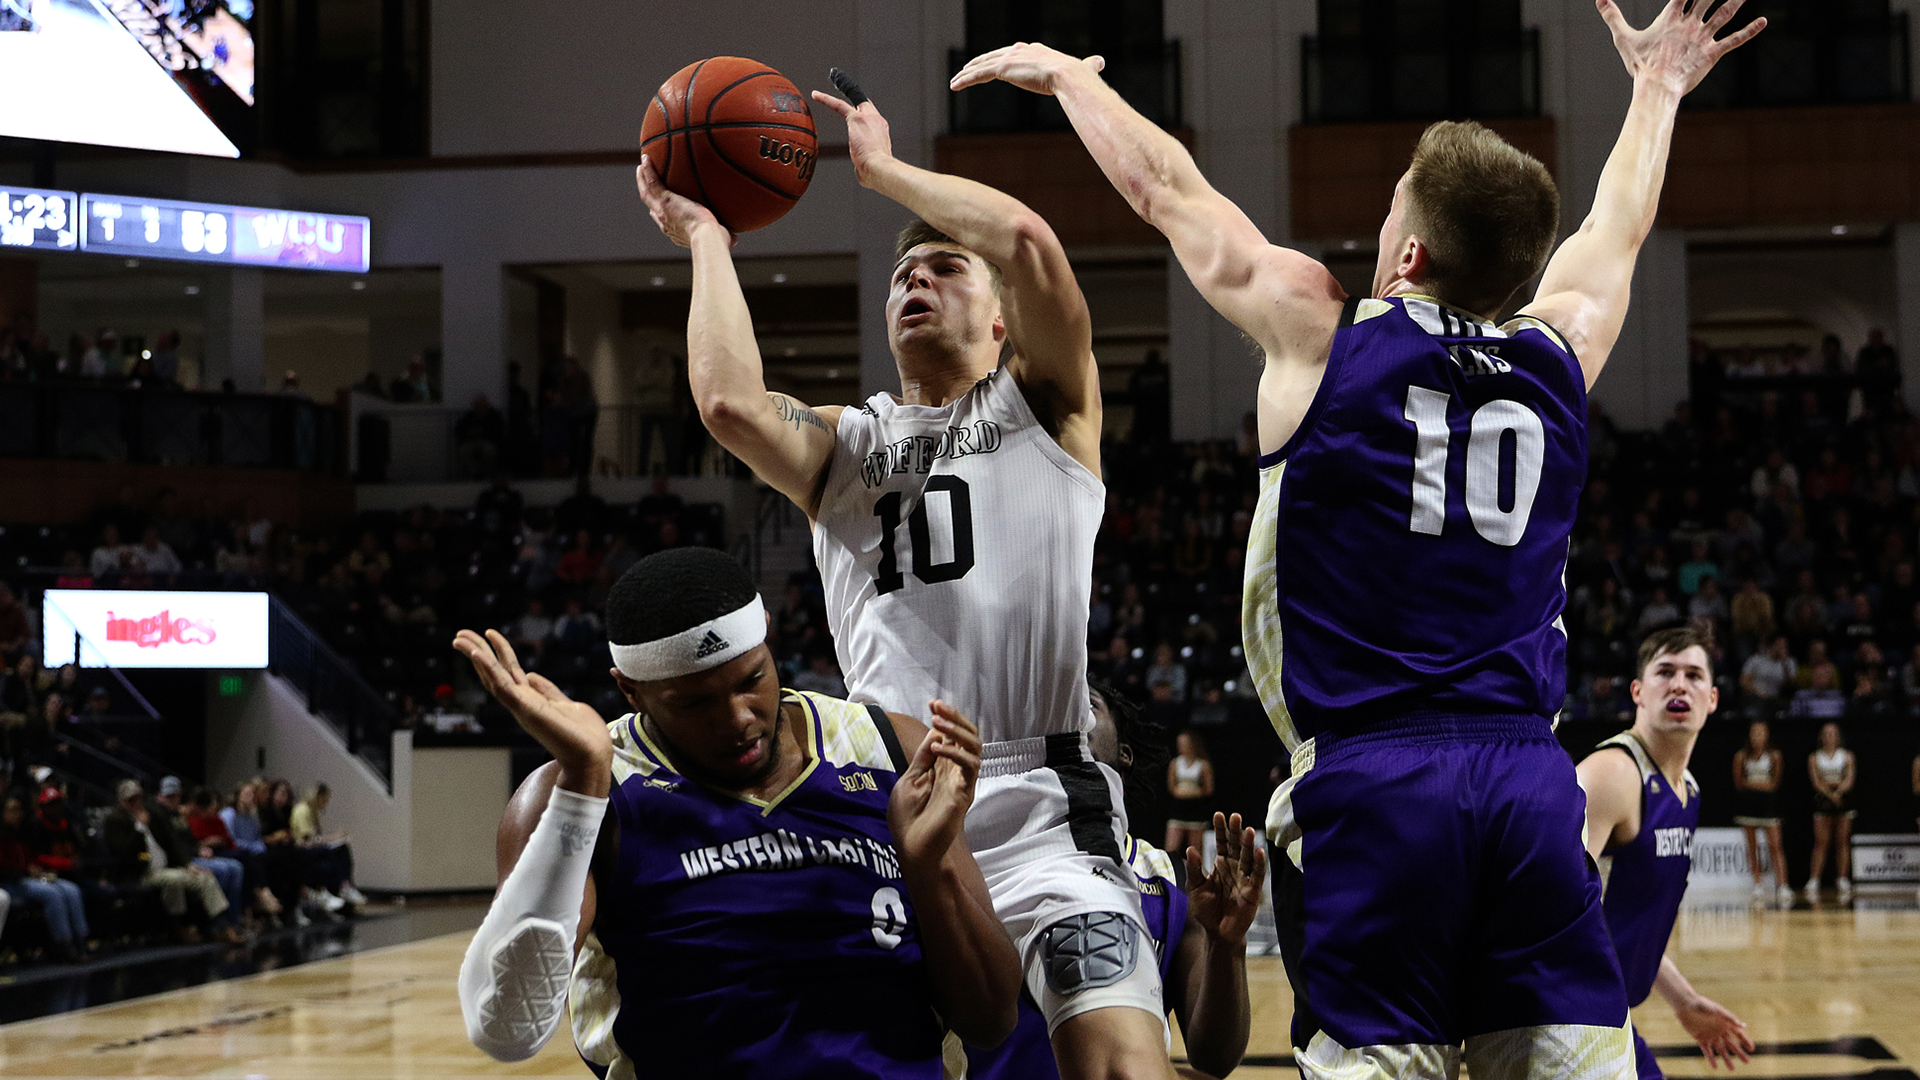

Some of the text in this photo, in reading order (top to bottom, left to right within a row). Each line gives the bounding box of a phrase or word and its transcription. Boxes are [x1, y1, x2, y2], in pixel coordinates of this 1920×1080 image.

[251, 213, 345, 254] WCU
[1404, 384, 1545, 547] 10
[873, 474, 975, 596] 10
[105, 609, 217, 649] ingles
[696, 640, 730, 659] adidas
[680, 828, 804, 879] WESTERN
[1689, 841, 1776, 874] OFFOD
[870, 886, 908, 950] 0
